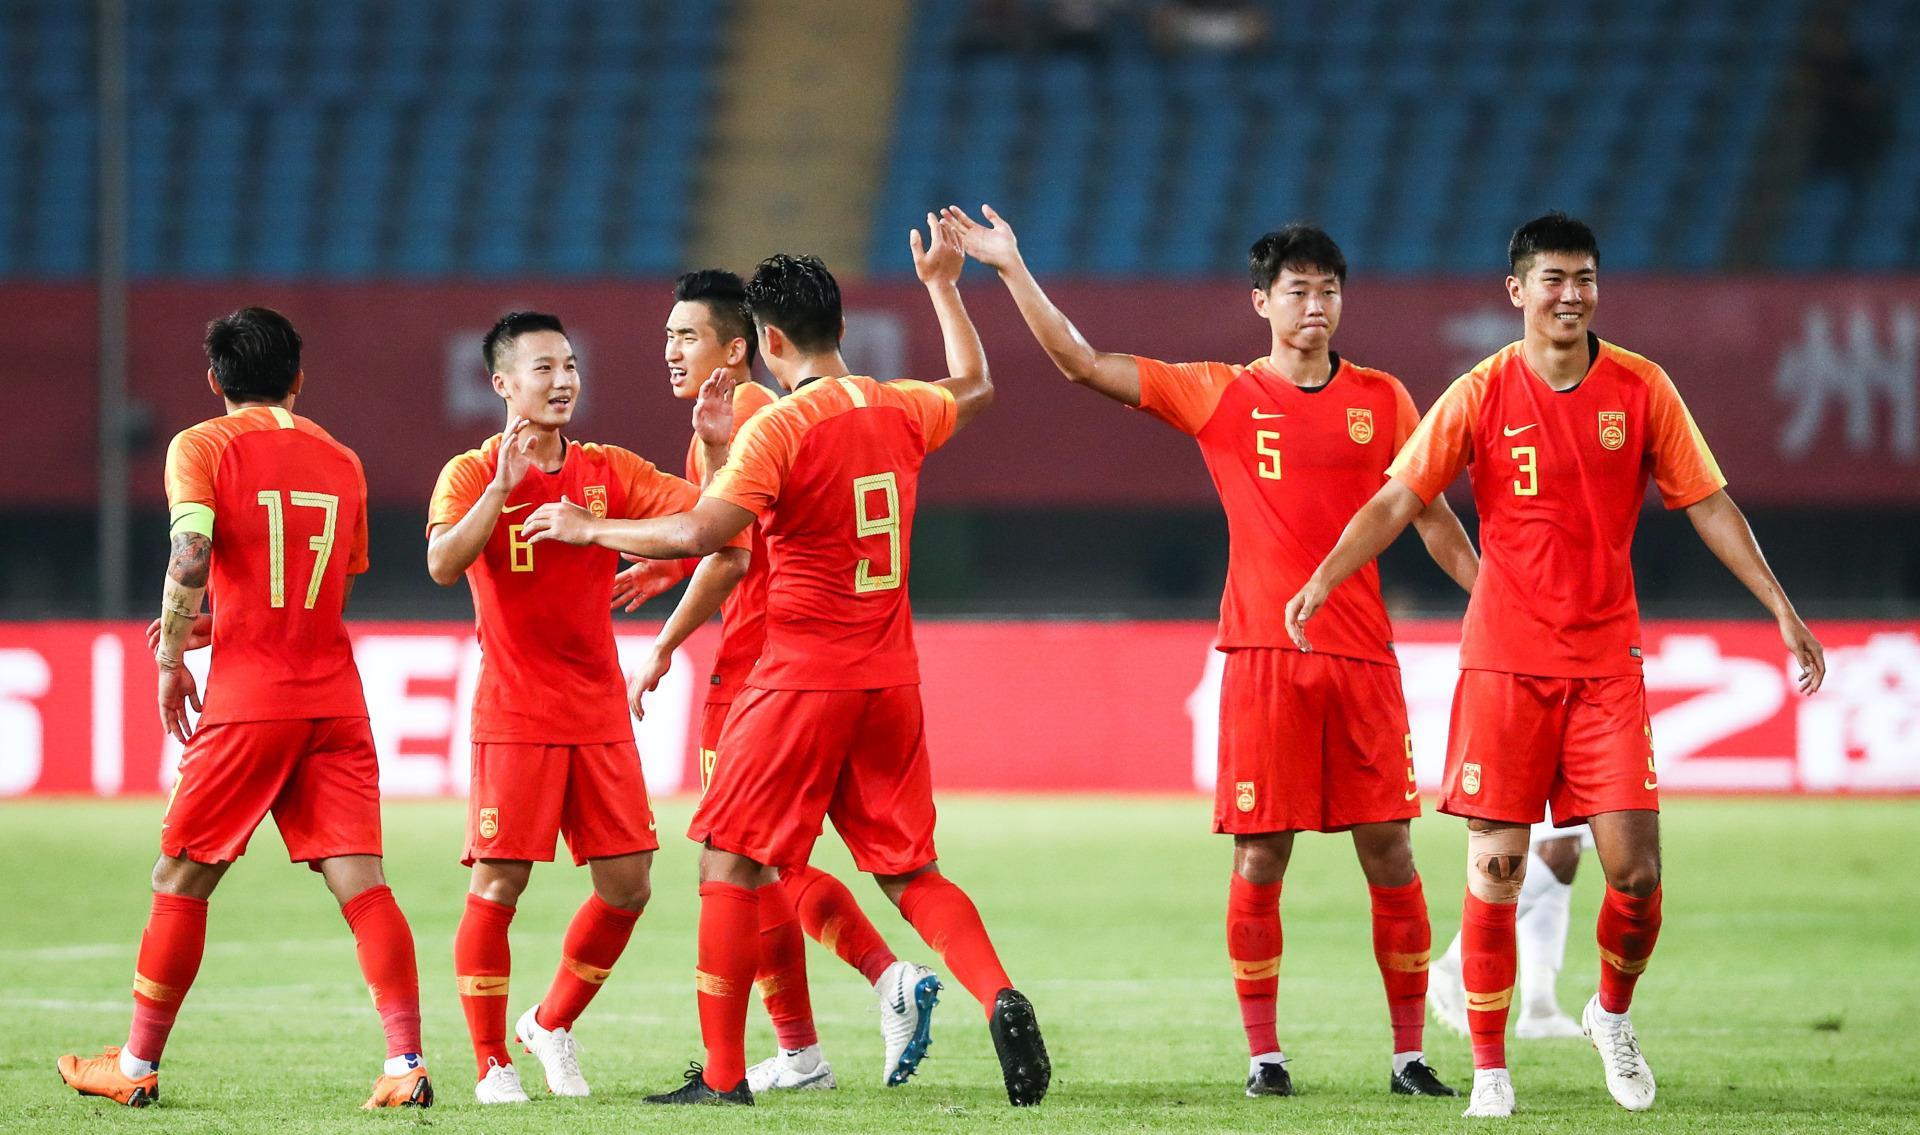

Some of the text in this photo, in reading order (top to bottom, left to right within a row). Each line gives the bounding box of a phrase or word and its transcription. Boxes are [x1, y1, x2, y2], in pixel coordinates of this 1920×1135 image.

[1256, 430, 1281, 480] 5
[1511, 446, 1538, 496] 3
[257, 490, 339, 610] 17
[509, 524, 533, 572] 6
[853, 471, 900, 593] 9
